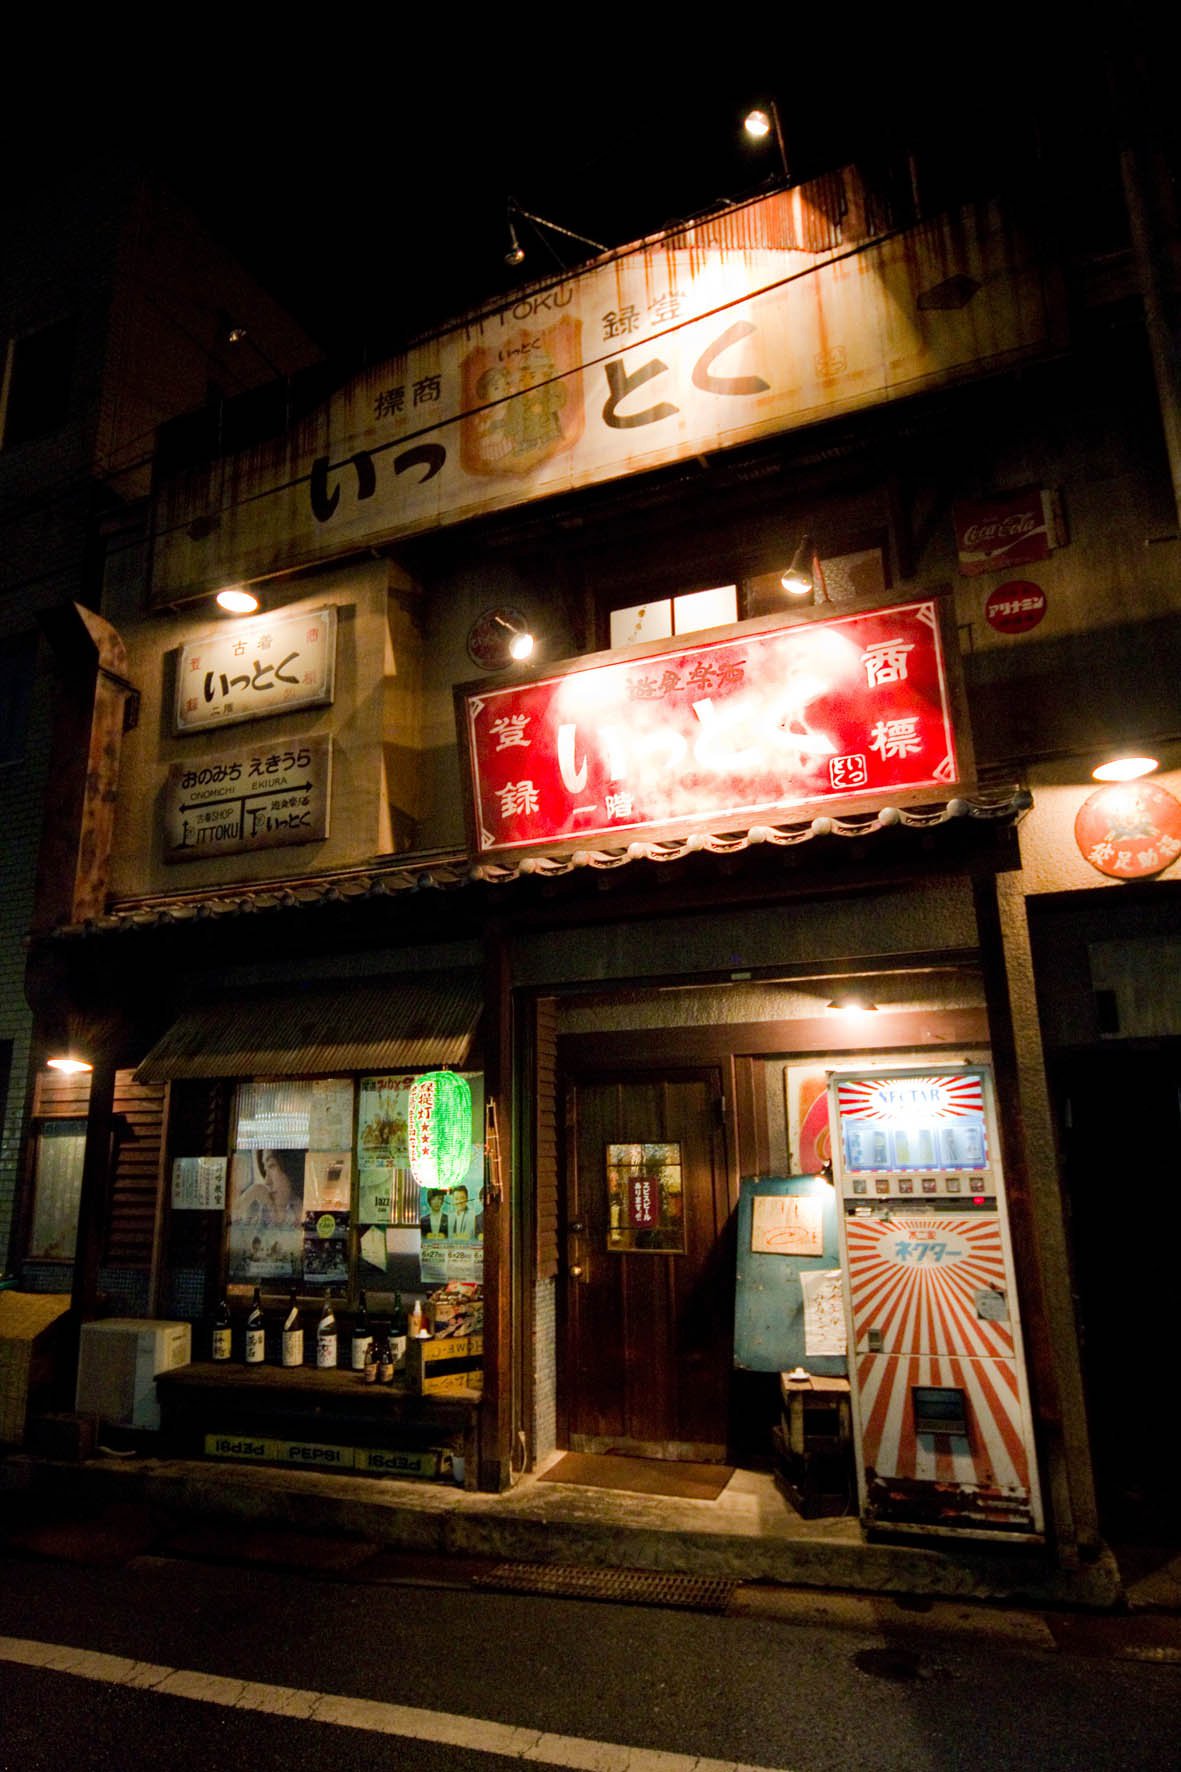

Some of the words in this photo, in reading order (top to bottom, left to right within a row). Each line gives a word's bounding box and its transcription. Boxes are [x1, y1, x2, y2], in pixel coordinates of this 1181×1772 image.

[498, 338, 541, 362] いっとく
[963, 512, 1035, 545] Coca-Cola
[988, 596, 1045, 619] アリナミン
[204, 652, 300, 703] いっとく
[861, 638, 924, 761] 商標
[557, 682, 838, 794] いっとく
[181, 762, 242, 789] おのみち
[248, 749, 312, 777] えきうら
[489, 715, 541, 819] 登録
[190, 786, 235, 800] ONOMICHI
[251, 777, 288, 790] EKIURA
[573, 793, 635, 820] 一階
[266, 811, 311, 832] いっとく
[878, 1088, 941, 1105] NECTAR
[895, 1240, 962, 1263] ネクター
[215, 1440, 265, 1456] PEPSI
[289, 1446, 340, 1462] PEPSI
[368, 1455, 421, 1472] PEPSI
